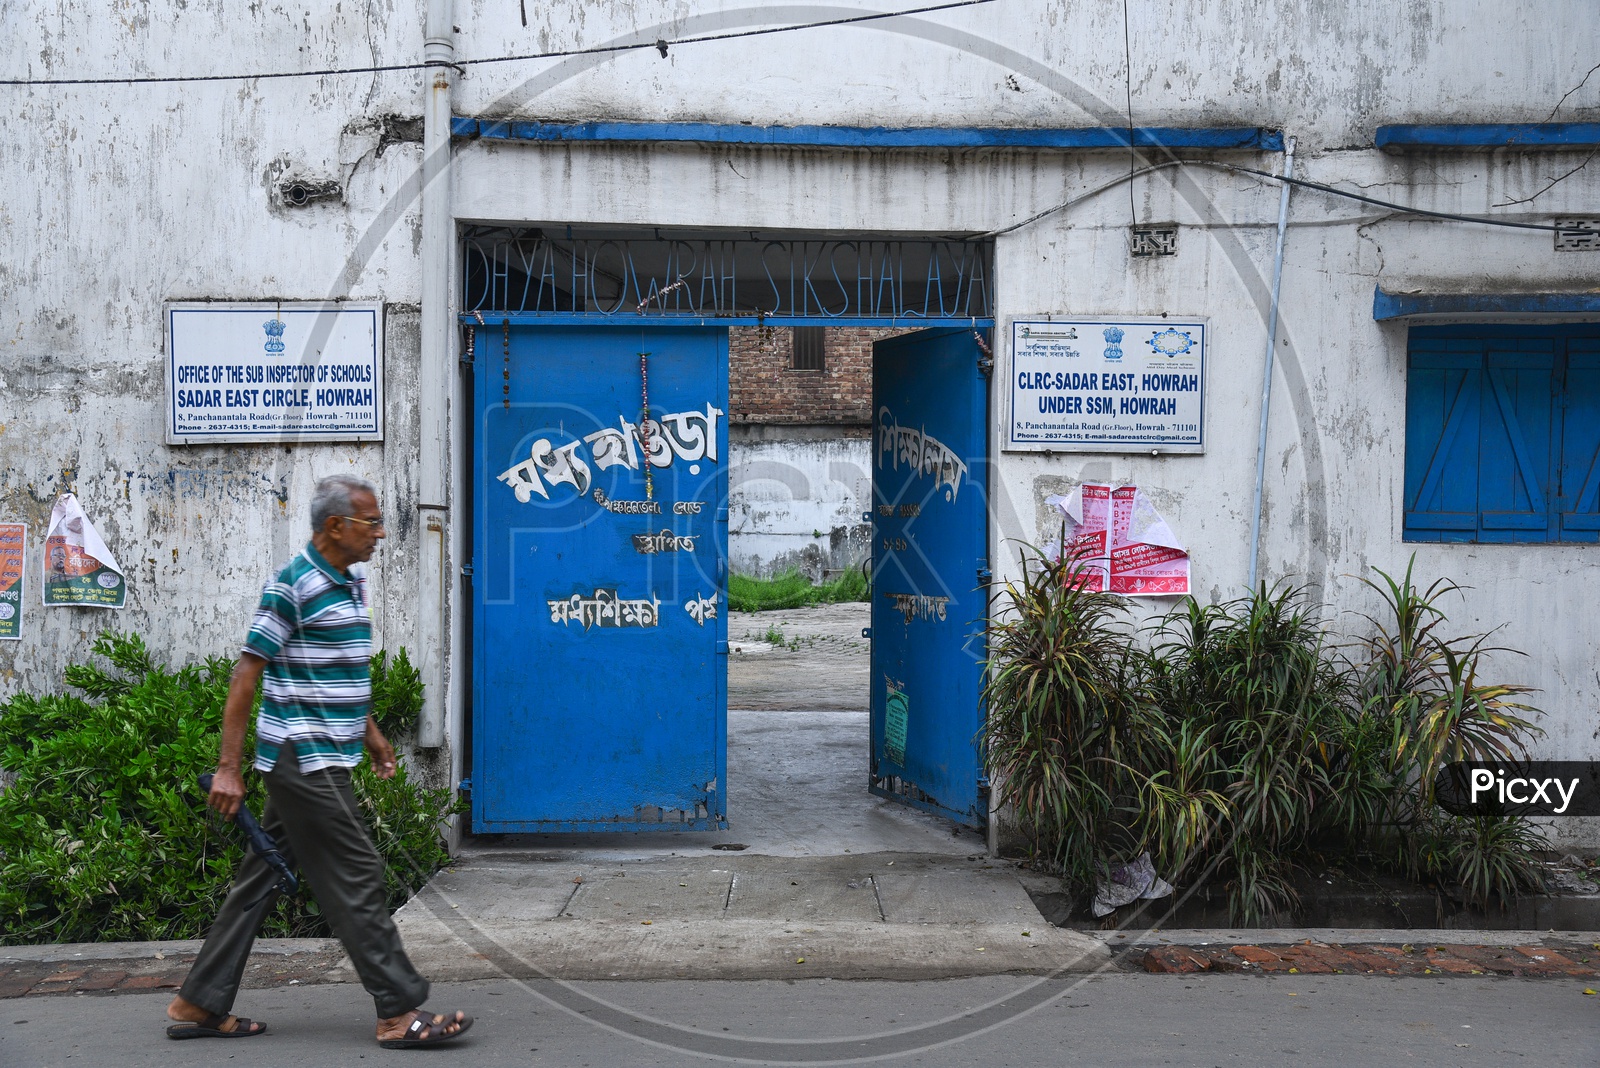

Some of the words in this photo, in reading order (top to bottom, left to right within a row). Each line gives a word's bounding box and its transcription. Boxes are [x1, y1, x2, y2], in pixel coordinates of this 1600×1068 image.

[572, 239, 735, 316] HOWRAH
[178, 365, 210, 384] OFFICE
[212, 365, 224, 383] OF
[226, 365, 244, 383] THE
[246, 365, 264, 383] SUB
[266, 365, 315, 383] INSPECTOR
[318, 365, 329, 382] OF
[331, 364, 372, 383] SCHOOLS
[1018, 372, 1098, 391] CLRC-SADAR
[1102, 373, 1138, 394] EAST,
[1142, 374, 1198, 392] HOWRAH
[178, 390, 222, 408] SADAR
[226, 390, 259, 408] EAST
[262, 389, 313, 410] CIRCLE,
[316, 388, 372, 406] HOWRAH
[1038, 396, 1082, 414] UNDER
[1086, 397, 1116, 418] SSM,
[1120, 398, 1176, 415] HOWRAH
[178, 414, 186, 422] 8,
[188, 413, 247, 421] Panchanantala
[306, 412, 338, 420] Howrah
[346, 412, 372, 420] 711101
[1016, 422, 1023, 430] 8,
[1025, 422, 1080, 430] Panchanantala
[1081, 422, 1100, 430] Road
[1172, 424, 1197, 432] 711101
[496, 438, 592, 503] মধ্য
[583, 401, 725, 475] হাওড়া
